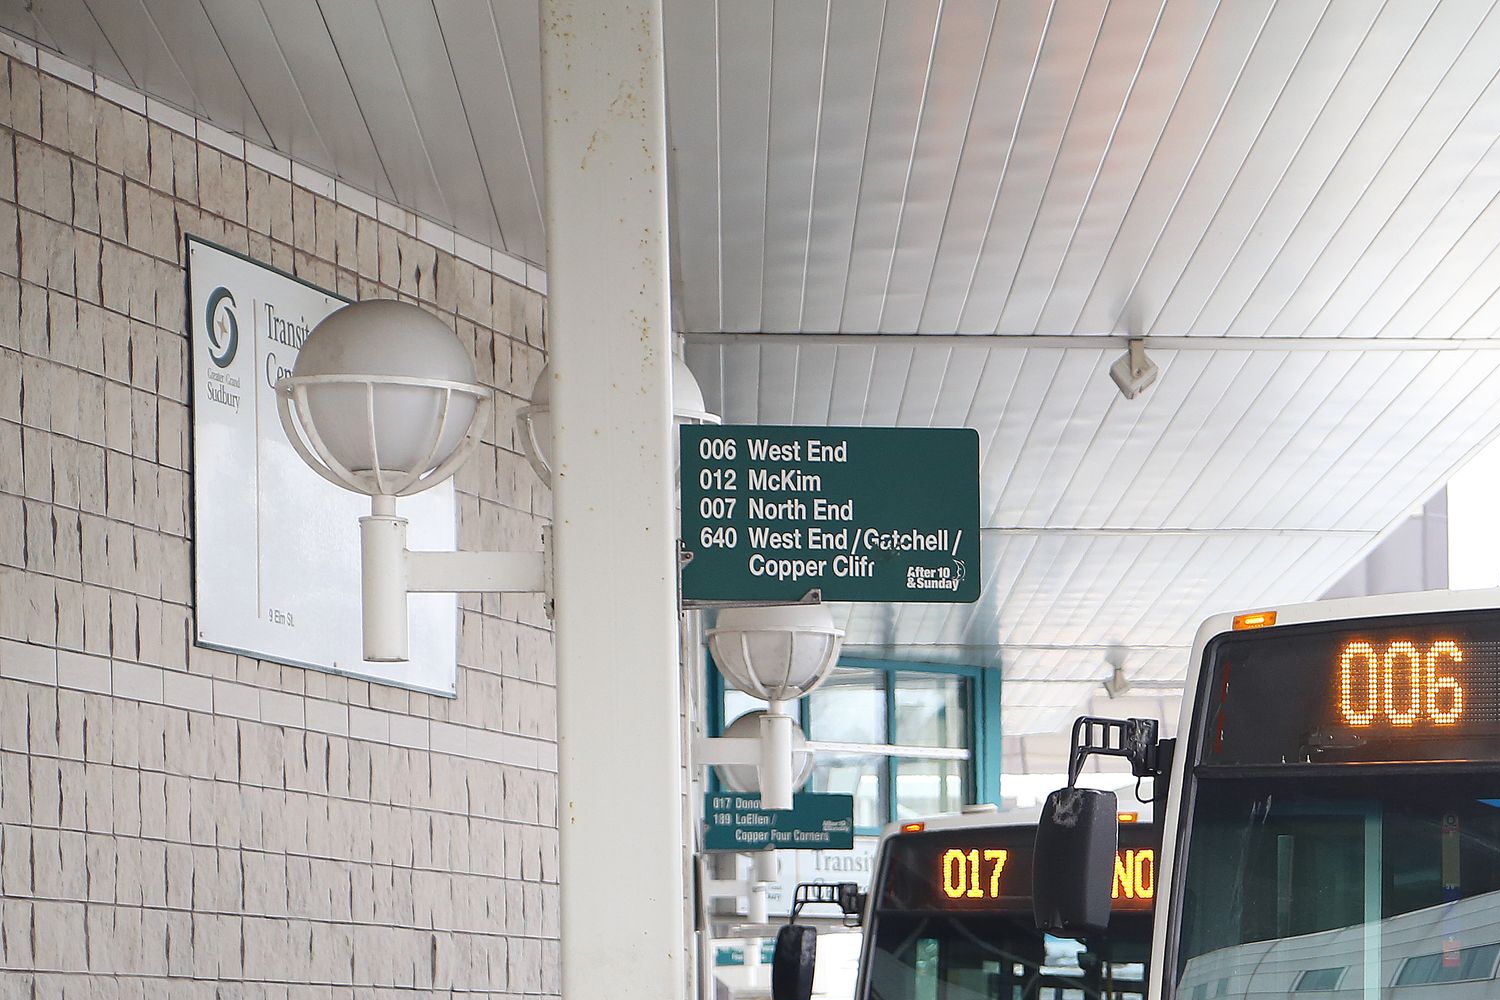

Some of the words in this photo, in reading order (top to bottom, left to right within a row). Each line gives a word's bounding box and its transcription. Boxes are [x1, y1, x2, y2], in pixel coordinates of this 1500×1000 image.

[266, 352, 293, 389] Cen
[207, 381, 240, 414] Sudbury
[699, 438, 737, 460] 006
[748, 439, 801, 462] West
[807, 440, 848, 462] End
[699, 469, 737, 490] 012
[748, 469, 821, 492] McKim
[699, 498, 737, 519] 007
[748, 498, 807, 520] North
[813, 499, 853, 521] End
[700, 527, 738, 548] 640
[748, 528, 801, 550] West
[748, 554, 827, 581] Copper
[906, 566, 937, 579] After
[937, 567, 951, 579] 10
[1340, 639, 1464, 727] 006
[735, 830, 768, 844] Copper
[770, 830, 793, 842] Four
[942, 848, 1008, 899] 017
